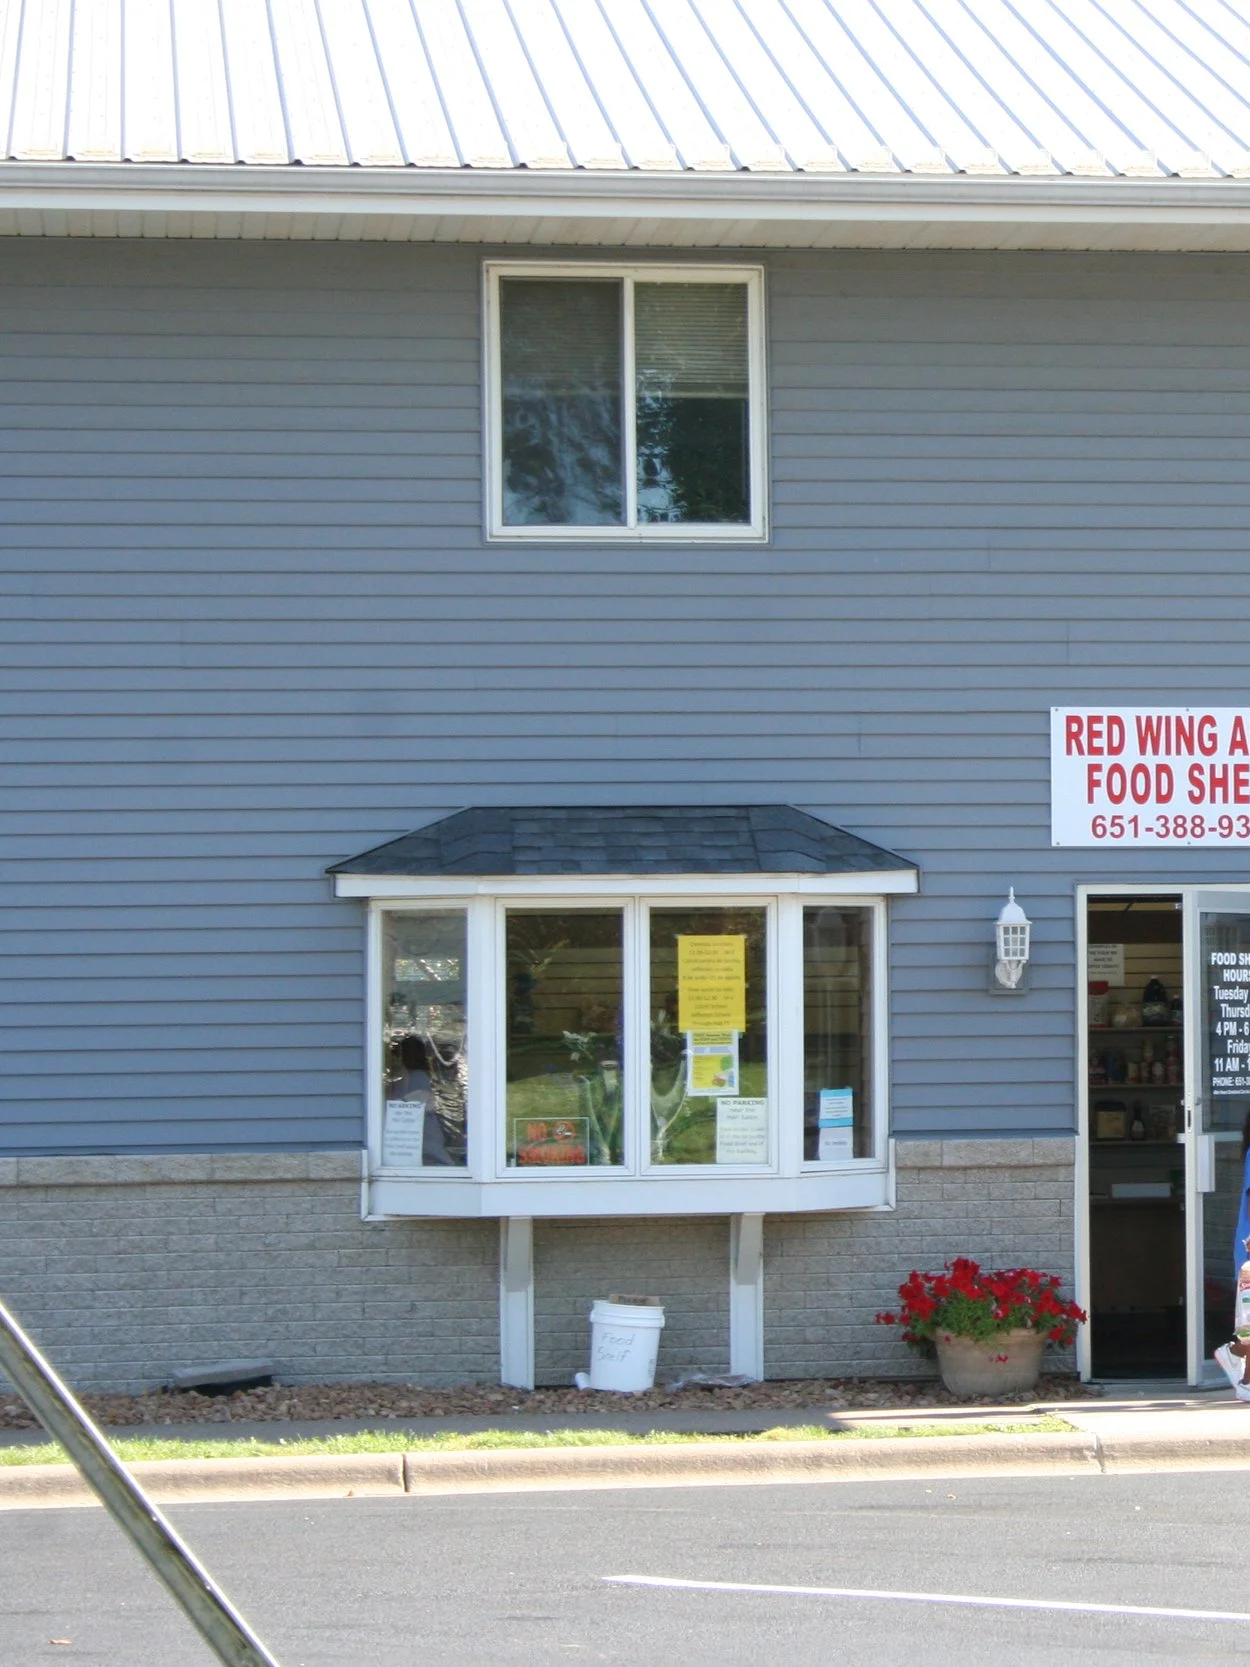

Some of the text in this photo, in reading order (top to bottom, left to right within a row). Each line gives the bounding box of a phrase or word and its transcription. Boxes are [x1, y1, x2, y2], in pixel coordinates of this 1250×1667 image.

[1065, 715, 1126, 756] RED
[1135, 714, 1218, 757] WING
[1087, 763, 1174, 805] FOOD
[1211, 952, 1237, 966] FOOD
[1213, 985, 1249, 1004] Tuesday
[1216, 1022, 1222, 1036] 4
[1223, 1022, 1237, 1036] PM
[1244, 1022, 1250, 1036] 6
[1214, 1057, 1223, 1072] 11
[1225, 1057, 1239, 1072] AM
[1246, 1057, 1250, 1072] 1
[602, 1332, 635, 1346] Food
